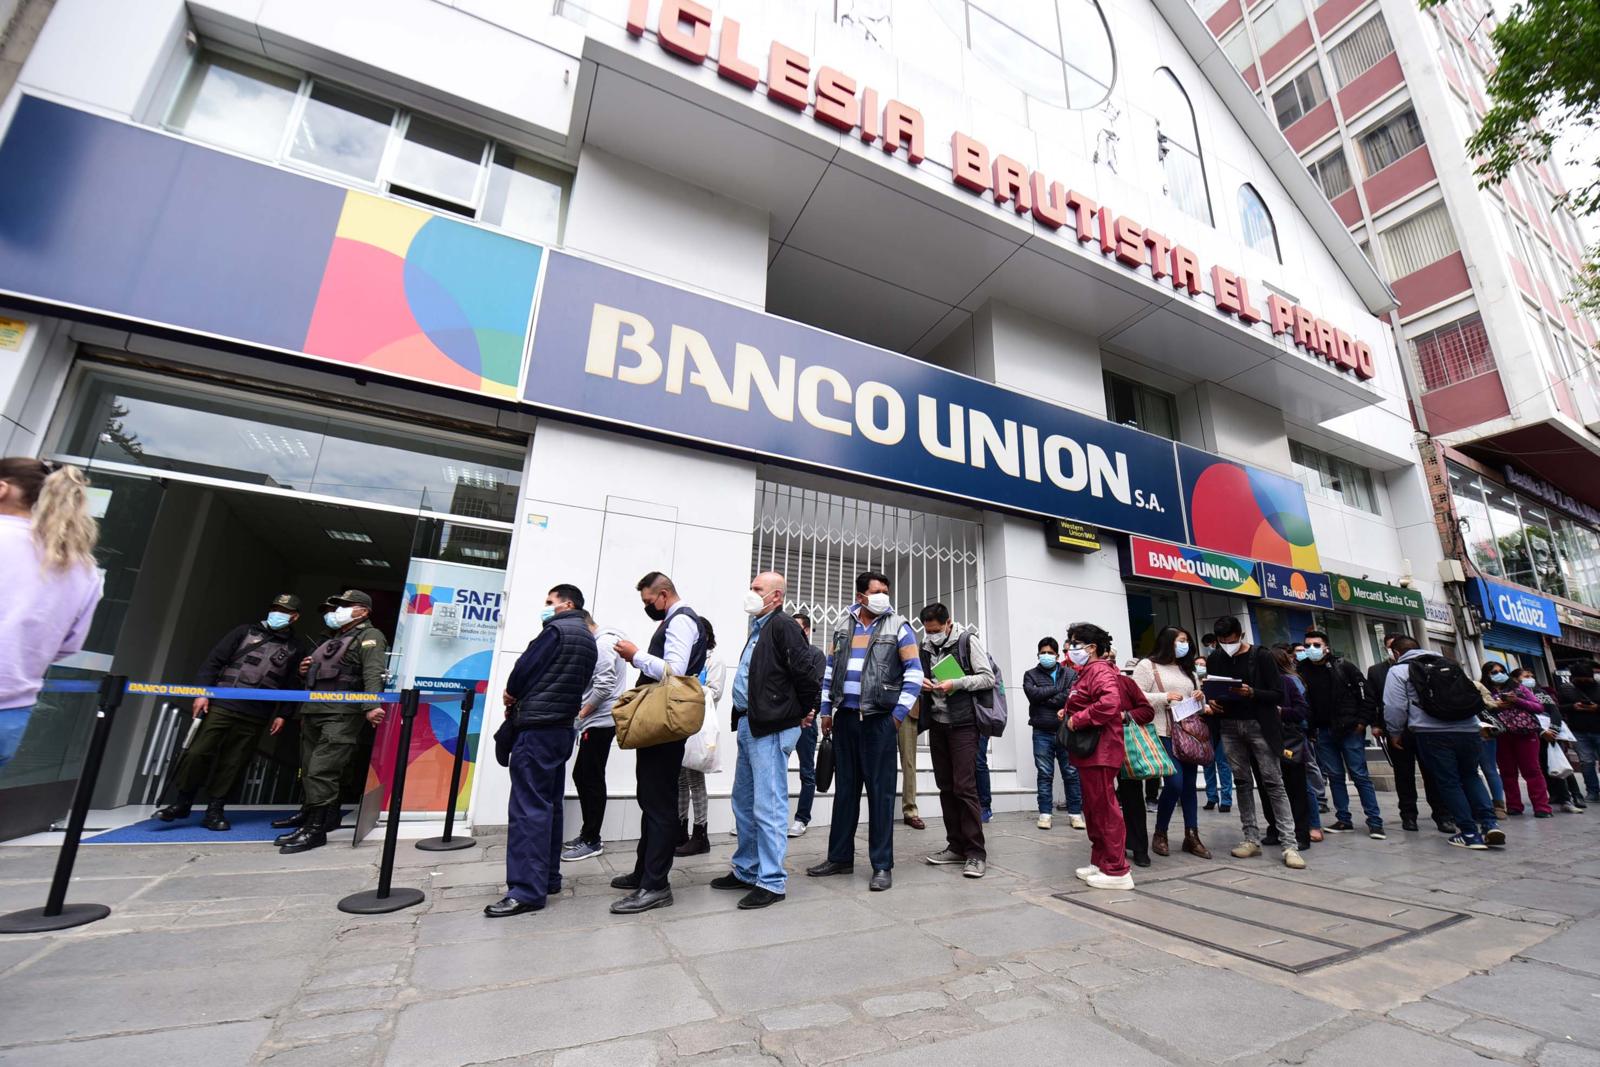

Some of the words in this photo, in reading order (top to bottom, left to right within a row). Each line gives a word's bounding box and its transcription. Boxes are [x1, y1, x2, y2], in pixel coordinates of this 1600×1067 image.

[626, 0, 925, 165] IGLESIA
[951, 131, 1201, 295] BAUTISTA
[1211, 265, 1261, 323] EL
[1267, 294, 1376, 380] PRADO
[585, 303, 905, 445] BANCO
[918, 394, 1131, 504] UNION
[1134, 489, 1165, 513] S.A.
[1148, 551, 1196, 575] BANCO
[1197, 561, 1240, 582] UNION
[1266, 572, 1276, 583] 24
[456, 589, 501, 607] SAFI
[1282, 585, 1316, 601] BancoSol
[1353, 586, 1384, 602] Mercantil
[1384, 592, 1404, 605] Santa
[1403, 596, 1419, 608] Cruz
[1499, 594, 1547, 628] Chávez
[128, 683, 167, 693] BANCO
[169, 686, 206, 696] UNION
[413, 680, 433, 688] ANCO
[309, 692, 343, 700] BANCO
[345, 693, 377, 701] UNION
